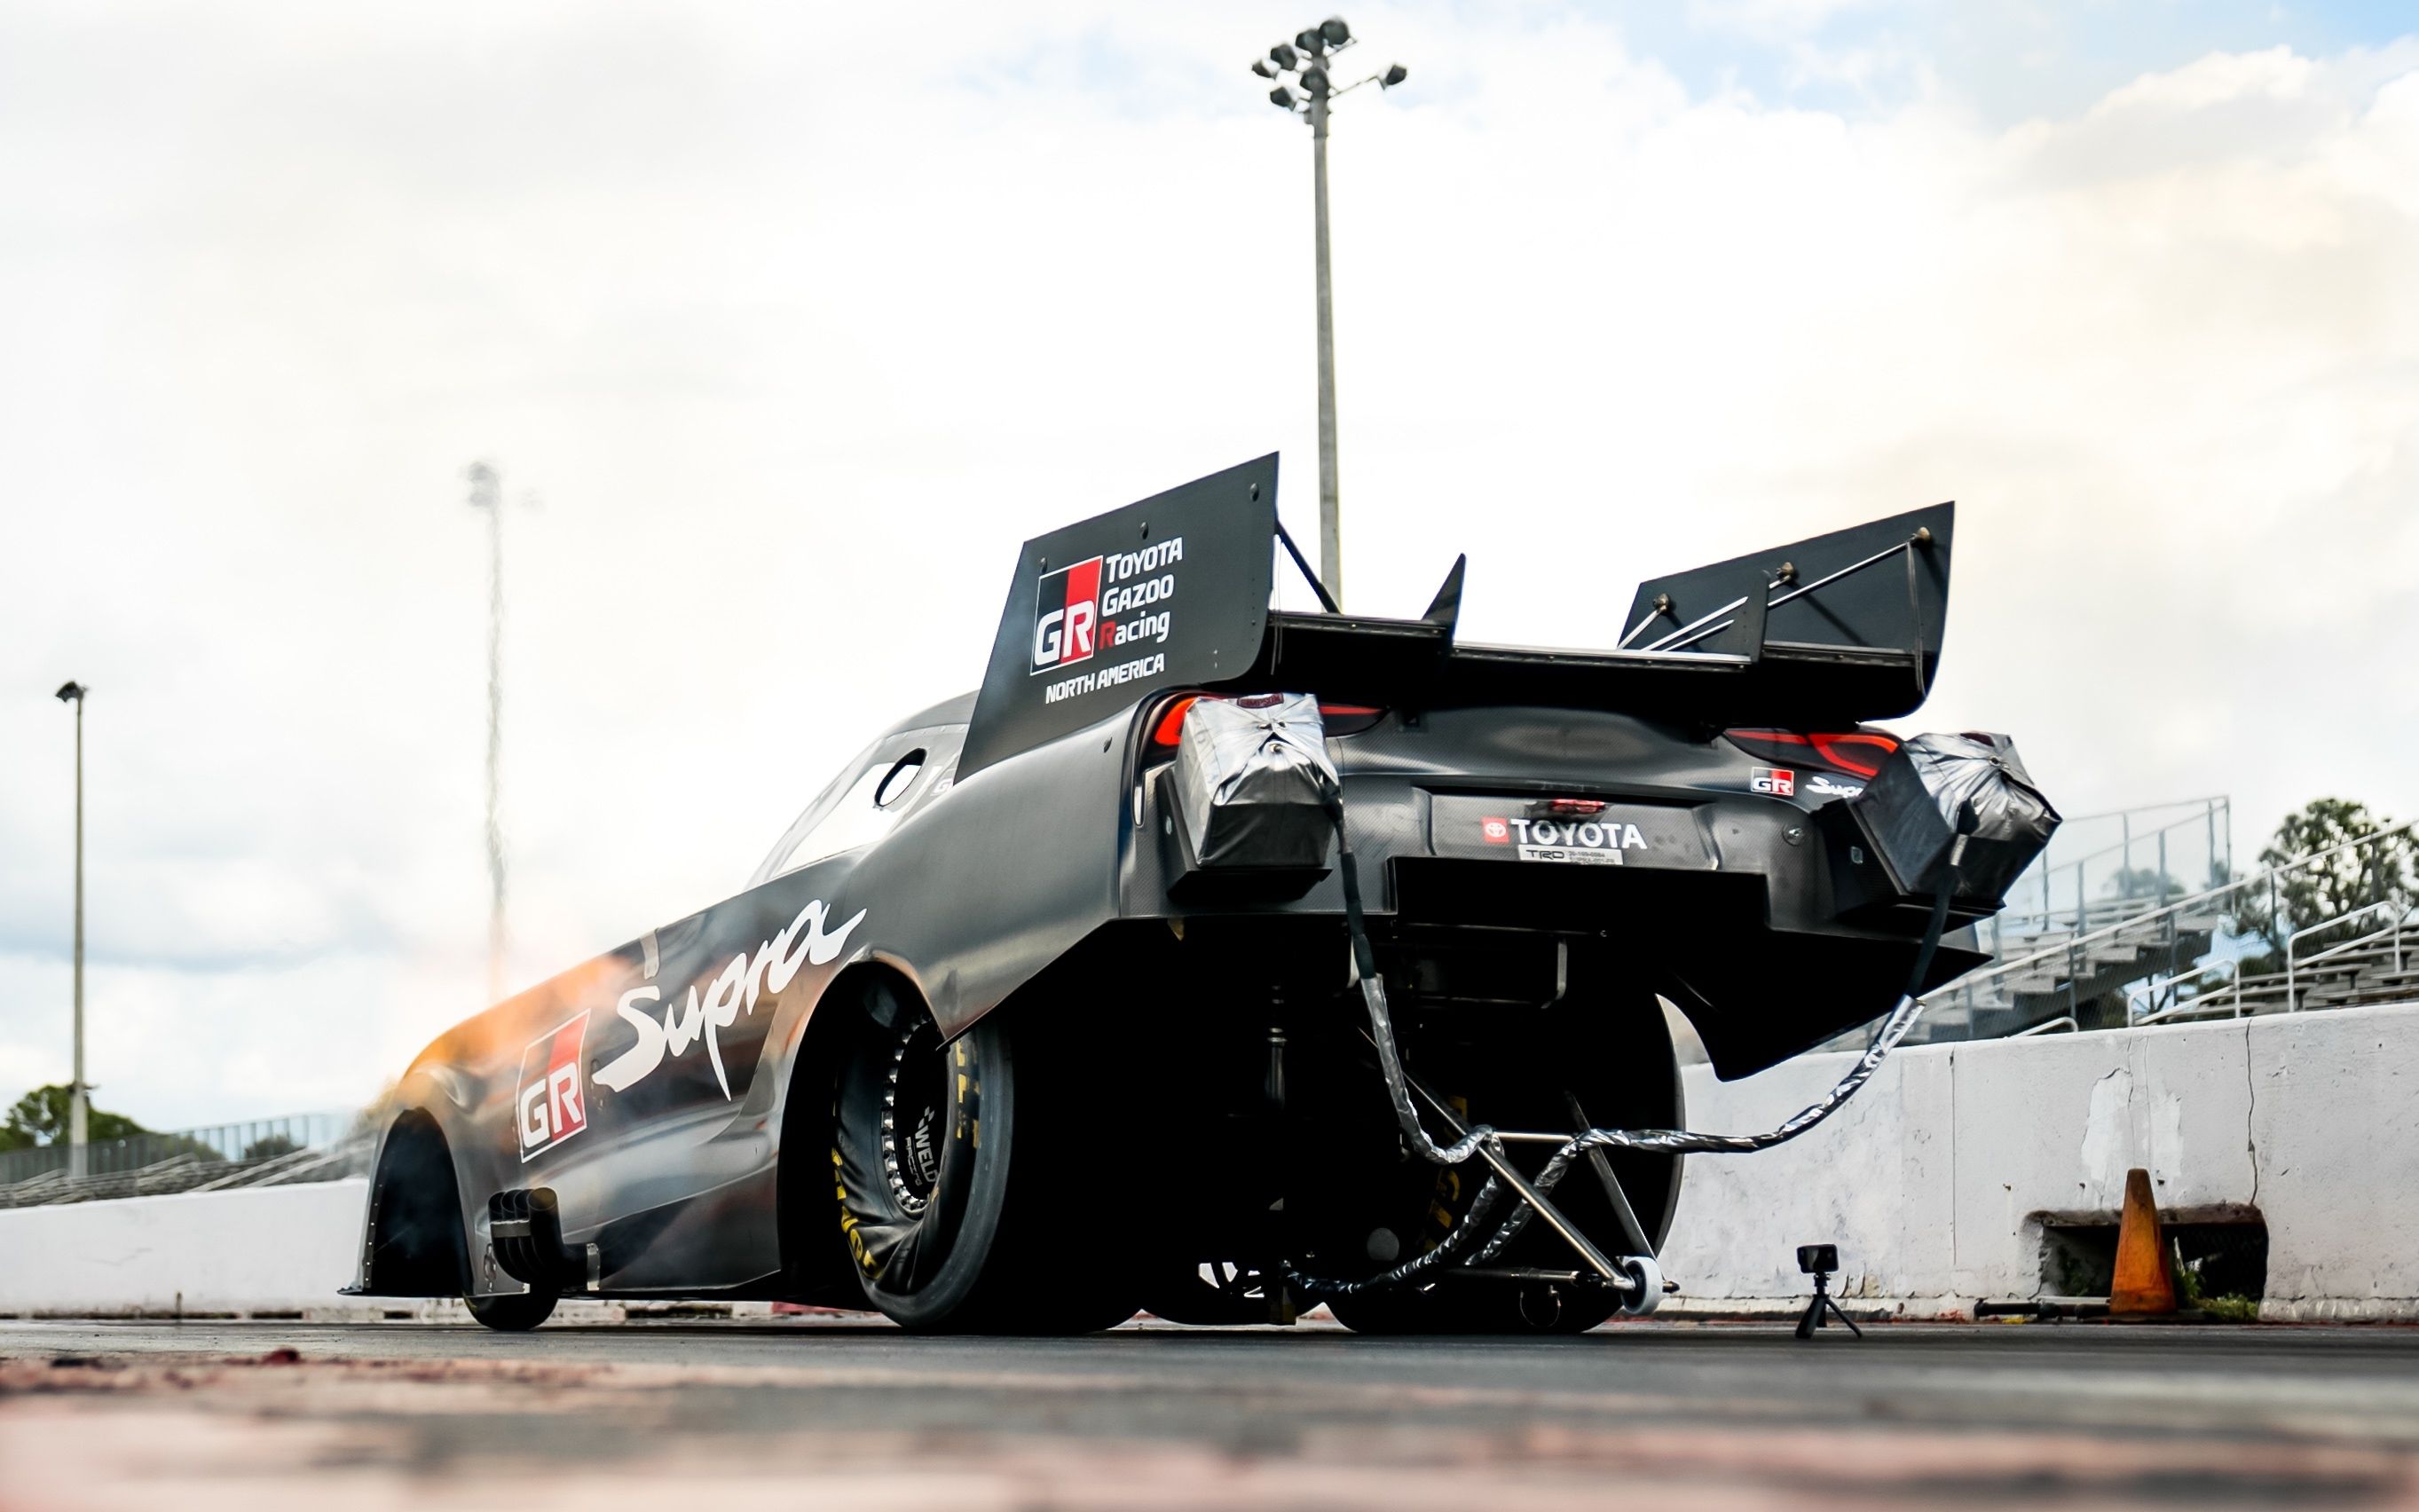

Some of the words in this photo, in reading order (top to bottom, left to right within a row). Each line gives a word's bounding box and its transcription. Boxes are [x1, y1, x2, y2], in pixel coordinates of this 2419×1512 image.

[1106, 537, 1184, 584] TOYOTA
[1101, 574, 1175, 618] GAZOO
[1034, 599, 1096, 666] GR
[1099, 610, 1171, 650] Racing
[1044, 673, 1096, 705] NORTH
[1097, 652, 1165, 690] AMERICA
[1752, 776, 1793, 794] GR
[1805, 776, 1864, 799] Supr
[1510, 818, 1648, 850] TOYOTA
[1525, 849, 1565, 861] TRD
[591, 899, 868, 1102] Supra
[519, 1061, 583, 1149] GR
[914, 1124, 940, 1183] WELD
